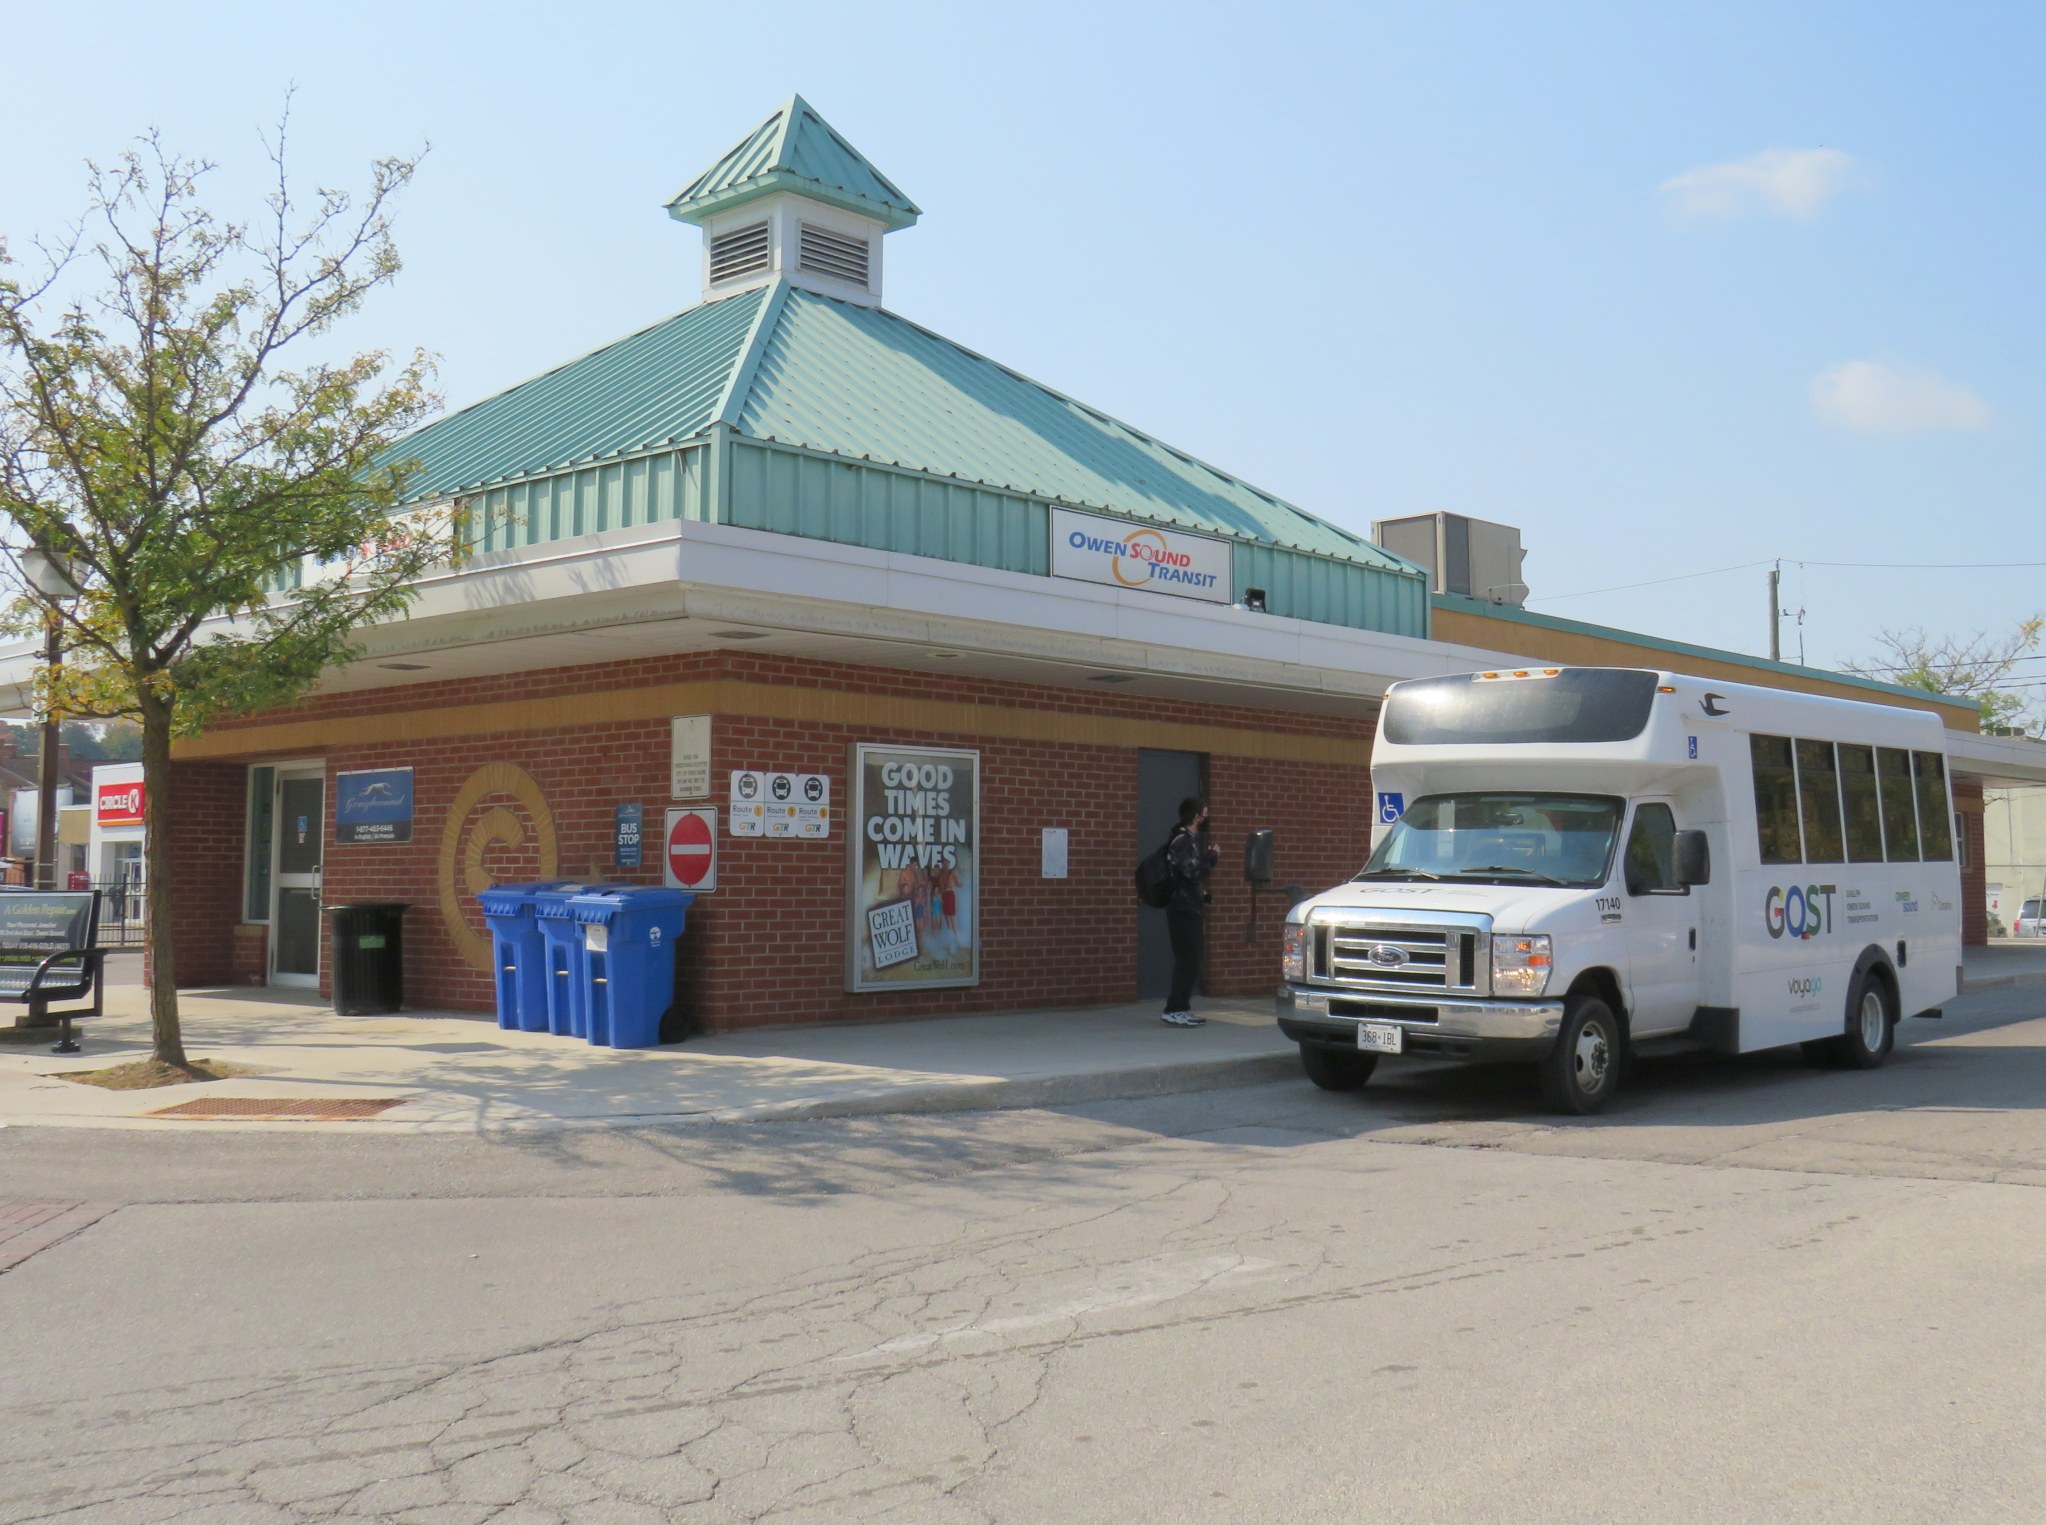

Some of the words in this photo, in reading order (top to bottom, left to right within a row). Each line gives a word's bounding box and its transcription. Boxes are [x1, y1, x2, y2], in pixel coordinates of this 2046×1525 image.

[1069, 531, 1127, 556] OWEN
[1130, 542, 1191, 567] SOUND
[1148, 562, 1217, 588] TRANSIT
[881, 762, 953, 790] GOOD
[100, 795, 128, 810] CIRCLE
[128, 788, 140, 814] K
[344, 794, 406, 814] Greyhound
[733, 805, 752, 813] Route
[766, 806, 786, 814] Route
[884, 789, 950, 816] TIMES
[620, 822, 638, 834] BUS
[739, 822, 756, 831] GTR
[772, 822, 790, 832] GTR
[805, 824, 821, 833] GTR
[867, 816, 934, 842] COME
[941, 818, 966, 843] IN
[618, 834, 640, 845] STOP
[877, 844, 956, 869] WAVES
[1596, 897, 1620, 911] 17140
[1766, 884, 1836, 939] GOST
[872, 904, 910, 930] GREAT
[874, 924, 912, 950] WOLF
[878, 946, 915, 964] LODGE
[1362, 1030, 1378, 1044] 368
